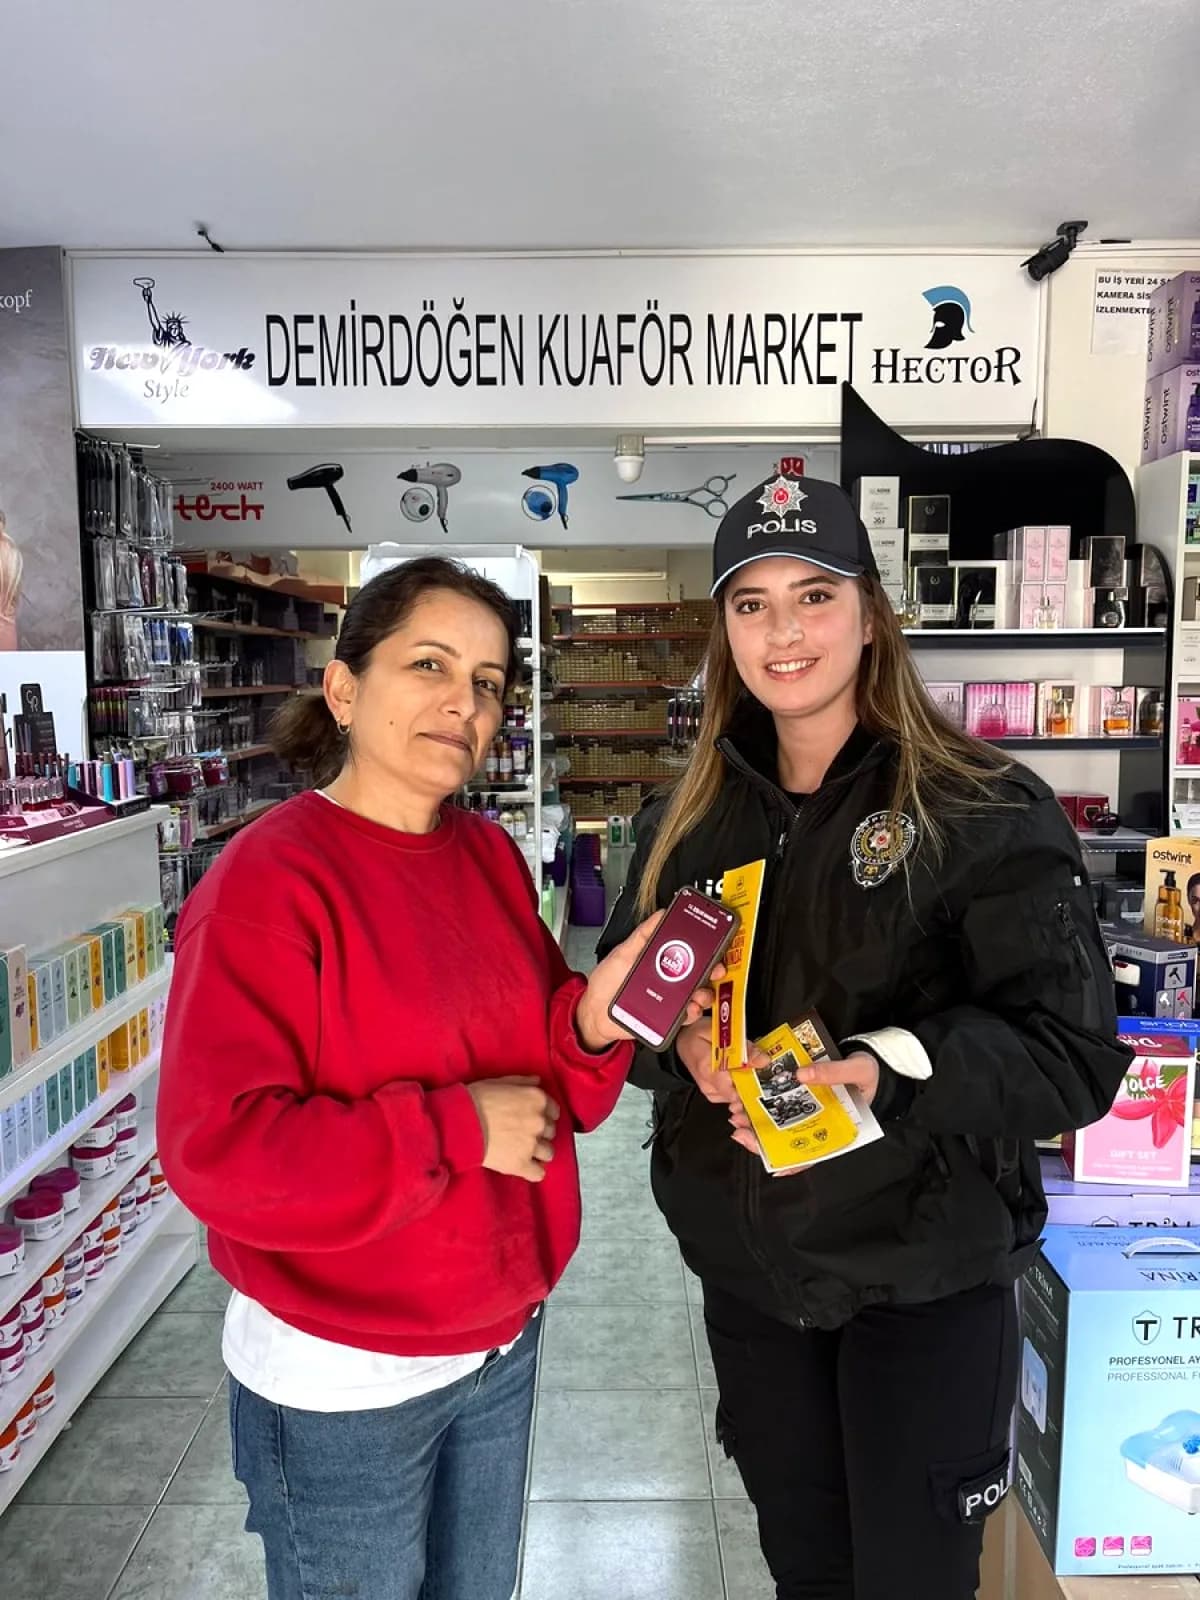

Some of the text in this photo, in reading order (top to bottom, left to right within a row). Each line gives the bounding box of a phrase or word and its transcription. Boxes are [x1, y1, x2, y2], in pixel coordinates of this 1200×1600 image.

[1098, 276, 1111, 284] BU
[1125, 276, 1145, 285] YERİ
[1097, 291, 1134, 299] KAMERA
[266, 297, 863, 387] DEMİRDÖĞEN KUAFÖR MARKET
[143, 379, 191, 404] Style
[210, 482, 264, 491] 2400 WATT
[747, 518, 817, 540] POLIS
[1152, 850, 1192, 864] ostwint
[1109, 1356, 1185, 1366] PROFESYONEL
[1107, 1371, 1188, 1382] PROFESSIONAL
